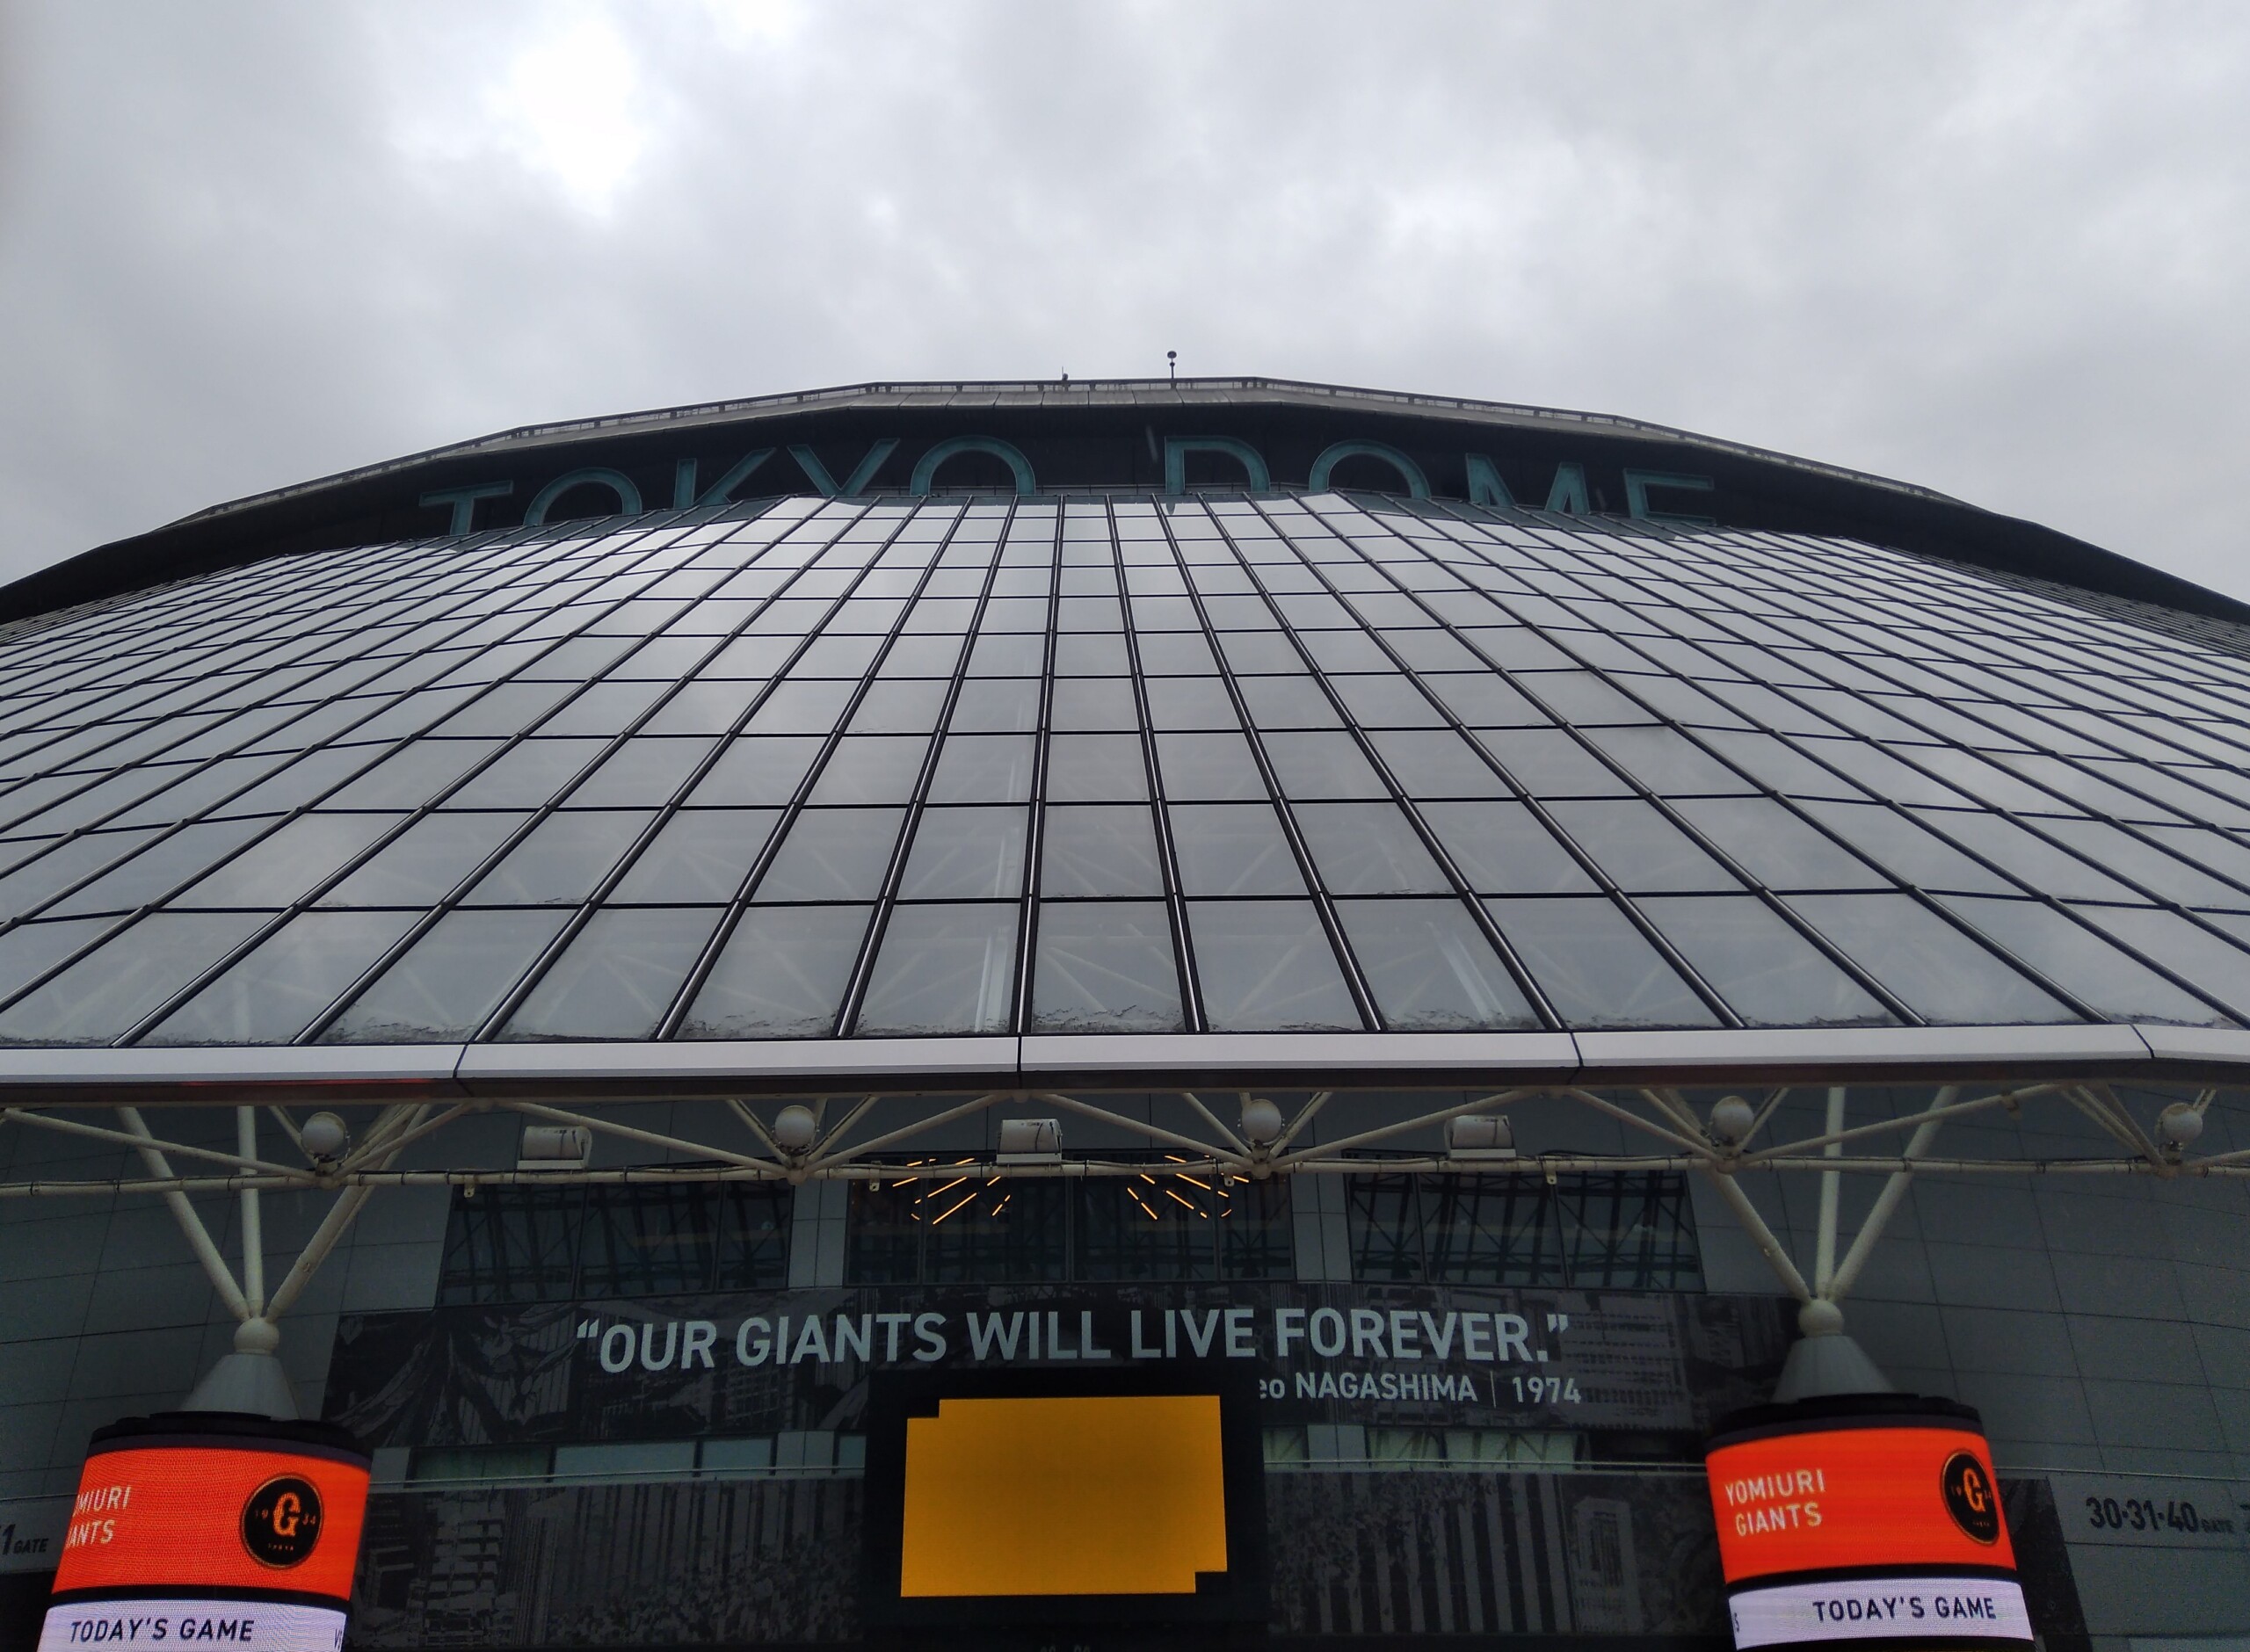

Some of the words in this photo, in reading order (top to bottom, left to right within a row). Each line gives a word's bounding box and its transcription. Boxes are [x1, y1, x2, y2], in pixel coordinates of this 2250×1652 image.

[735, 1312, 947, 1366] GIANTS
[966, 1310, 1113, 1362] WILL
[1130, 1308, 1257, 1359] LIVE
[1259, 1378, 1286, 1400] eo
[1295, 1371, 1479, 1402] NAGASHIMA
[1512, 1375, 1582, 1405] 1974
[1724, 1467, 1825, 1507] YOMIURI
[1963, 1467, 1987, 1512] G
[273, 1492, 301, 1537] G
[1735, 1500, 1824, 1537] GIANTS
[14, 1538, 49, 1554] GATE
[1811, 1596, 1925, 1623] TODAY'S
[1934, 1595, 1997, 1619] GAME
[69, 1617, 168, 1642] TODAY'S
[179, 1617, 255, 1641] GAME
